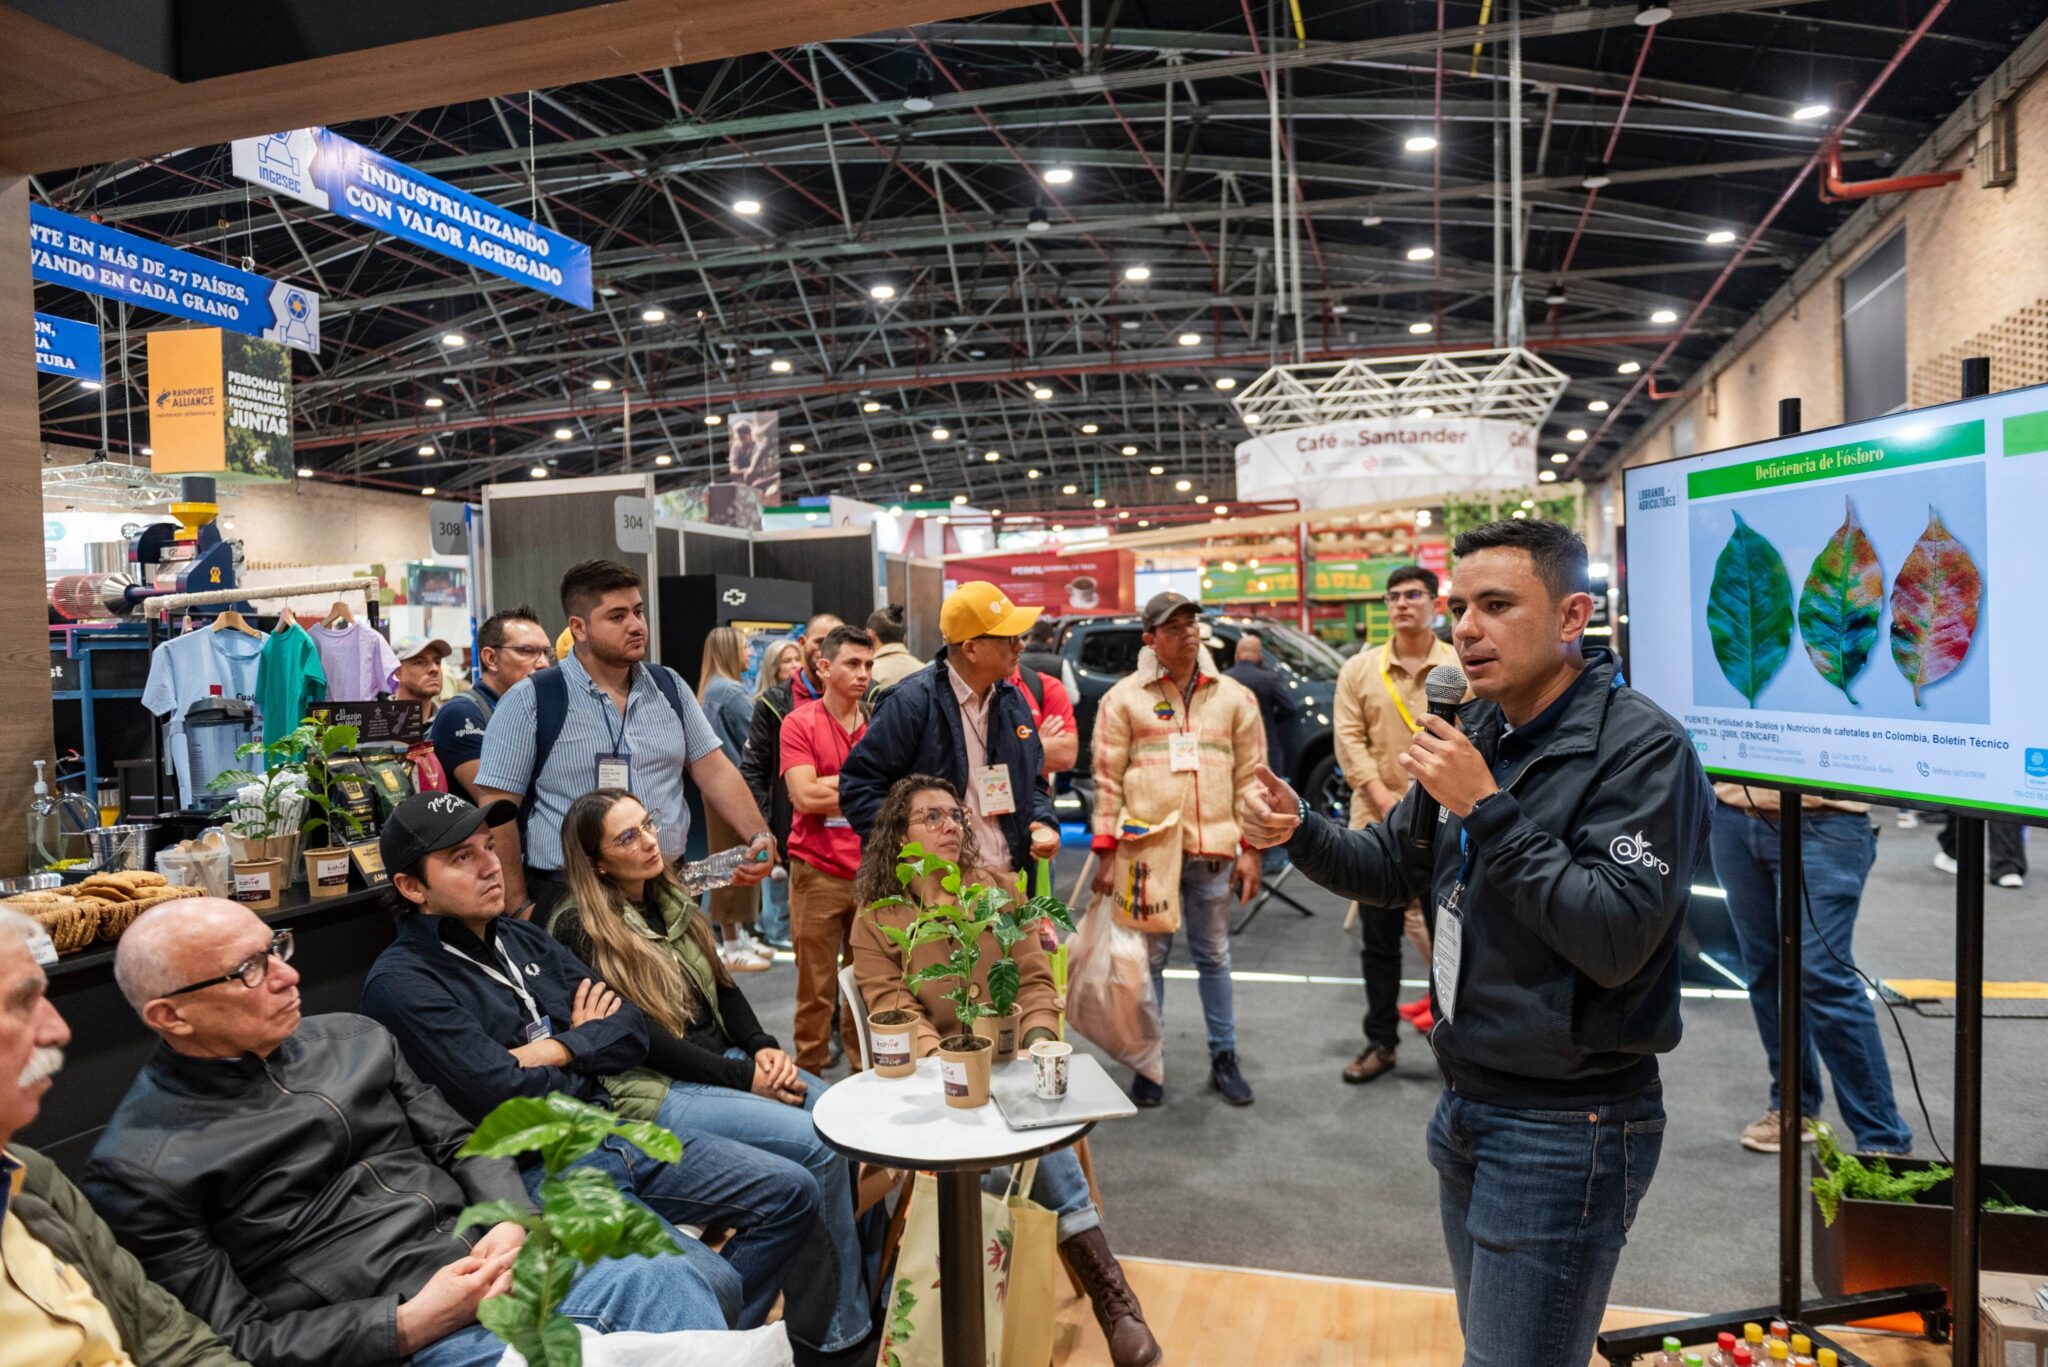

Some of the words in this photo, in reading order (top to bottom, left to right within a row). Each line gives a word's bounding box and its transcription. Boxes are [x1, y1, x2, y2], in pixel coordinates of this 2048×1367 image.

[361, 162, 549, 256] INDUSTRIALIZANDO
[346, 185, 393, 220] CON
[397, 206, 464, 248] VALOR
[467, 235, 563, 286] AGREGADO
[29, 223, 64, 248] NTE
[68, 234, 95, 257] EN
[99, 245, 138, 269] MÁS
[142, 257, 166, 278] DE
[169, 269, 188, 286] 27
[192, 273, 249, 305] PAÍSES,
[30, 248, 95, 280] VANDO
[100, 271, 125, 289] EN
[129, 278, 178, 304] CADA
[182, 293, 240, 320] GRANO
[36, 352, 76, 370] TURA
[172, 387, 214, 396] RAINFOREST
[228, 370, 279, 392] PERSONAS
[279, 383, 286, 394] Y
[172, 395, 215, 408] ALLIANCE
[228, 384, 286, 406] NATURALEZA
[228, 398, 287, 418] PROSPERANDO
[229, 409, 288, 436] JUNTAS
[1296, 432, 1337, 453] Café
[1359, 428, 1468, 447] Santander
[1755, 458, 1816, 481] Deficiencia
[1819, 454, 1833, 470] de
[1836, 448, 1884, 468] Fósforo
[1639, 496, 1676, 511] AGRICULTORES
[439, 522, 461, 537] 308
[623, 514, 643, 529] 304
[1684, 714, 1711, 725] FUENTE:
[1713, 717, 1744, 728] Fertilidad
[1745, 720, 1754, 729] de
[1755, 720, 1779, 731] Suelos
[1780, 725, 1785, 733] y
[1787, 723, 1821, 735] Nutrición
[1822, 726, 1832, 735] de
[1834, 727, 1870, 738] cafetales
[1872, 731, 1883, 739] en
[1885, 730, 1930, 744] Colombia,
[1969, 737, 2010, 750] Técnico
[1740, 732, 1780, 743] CENICAFE)
